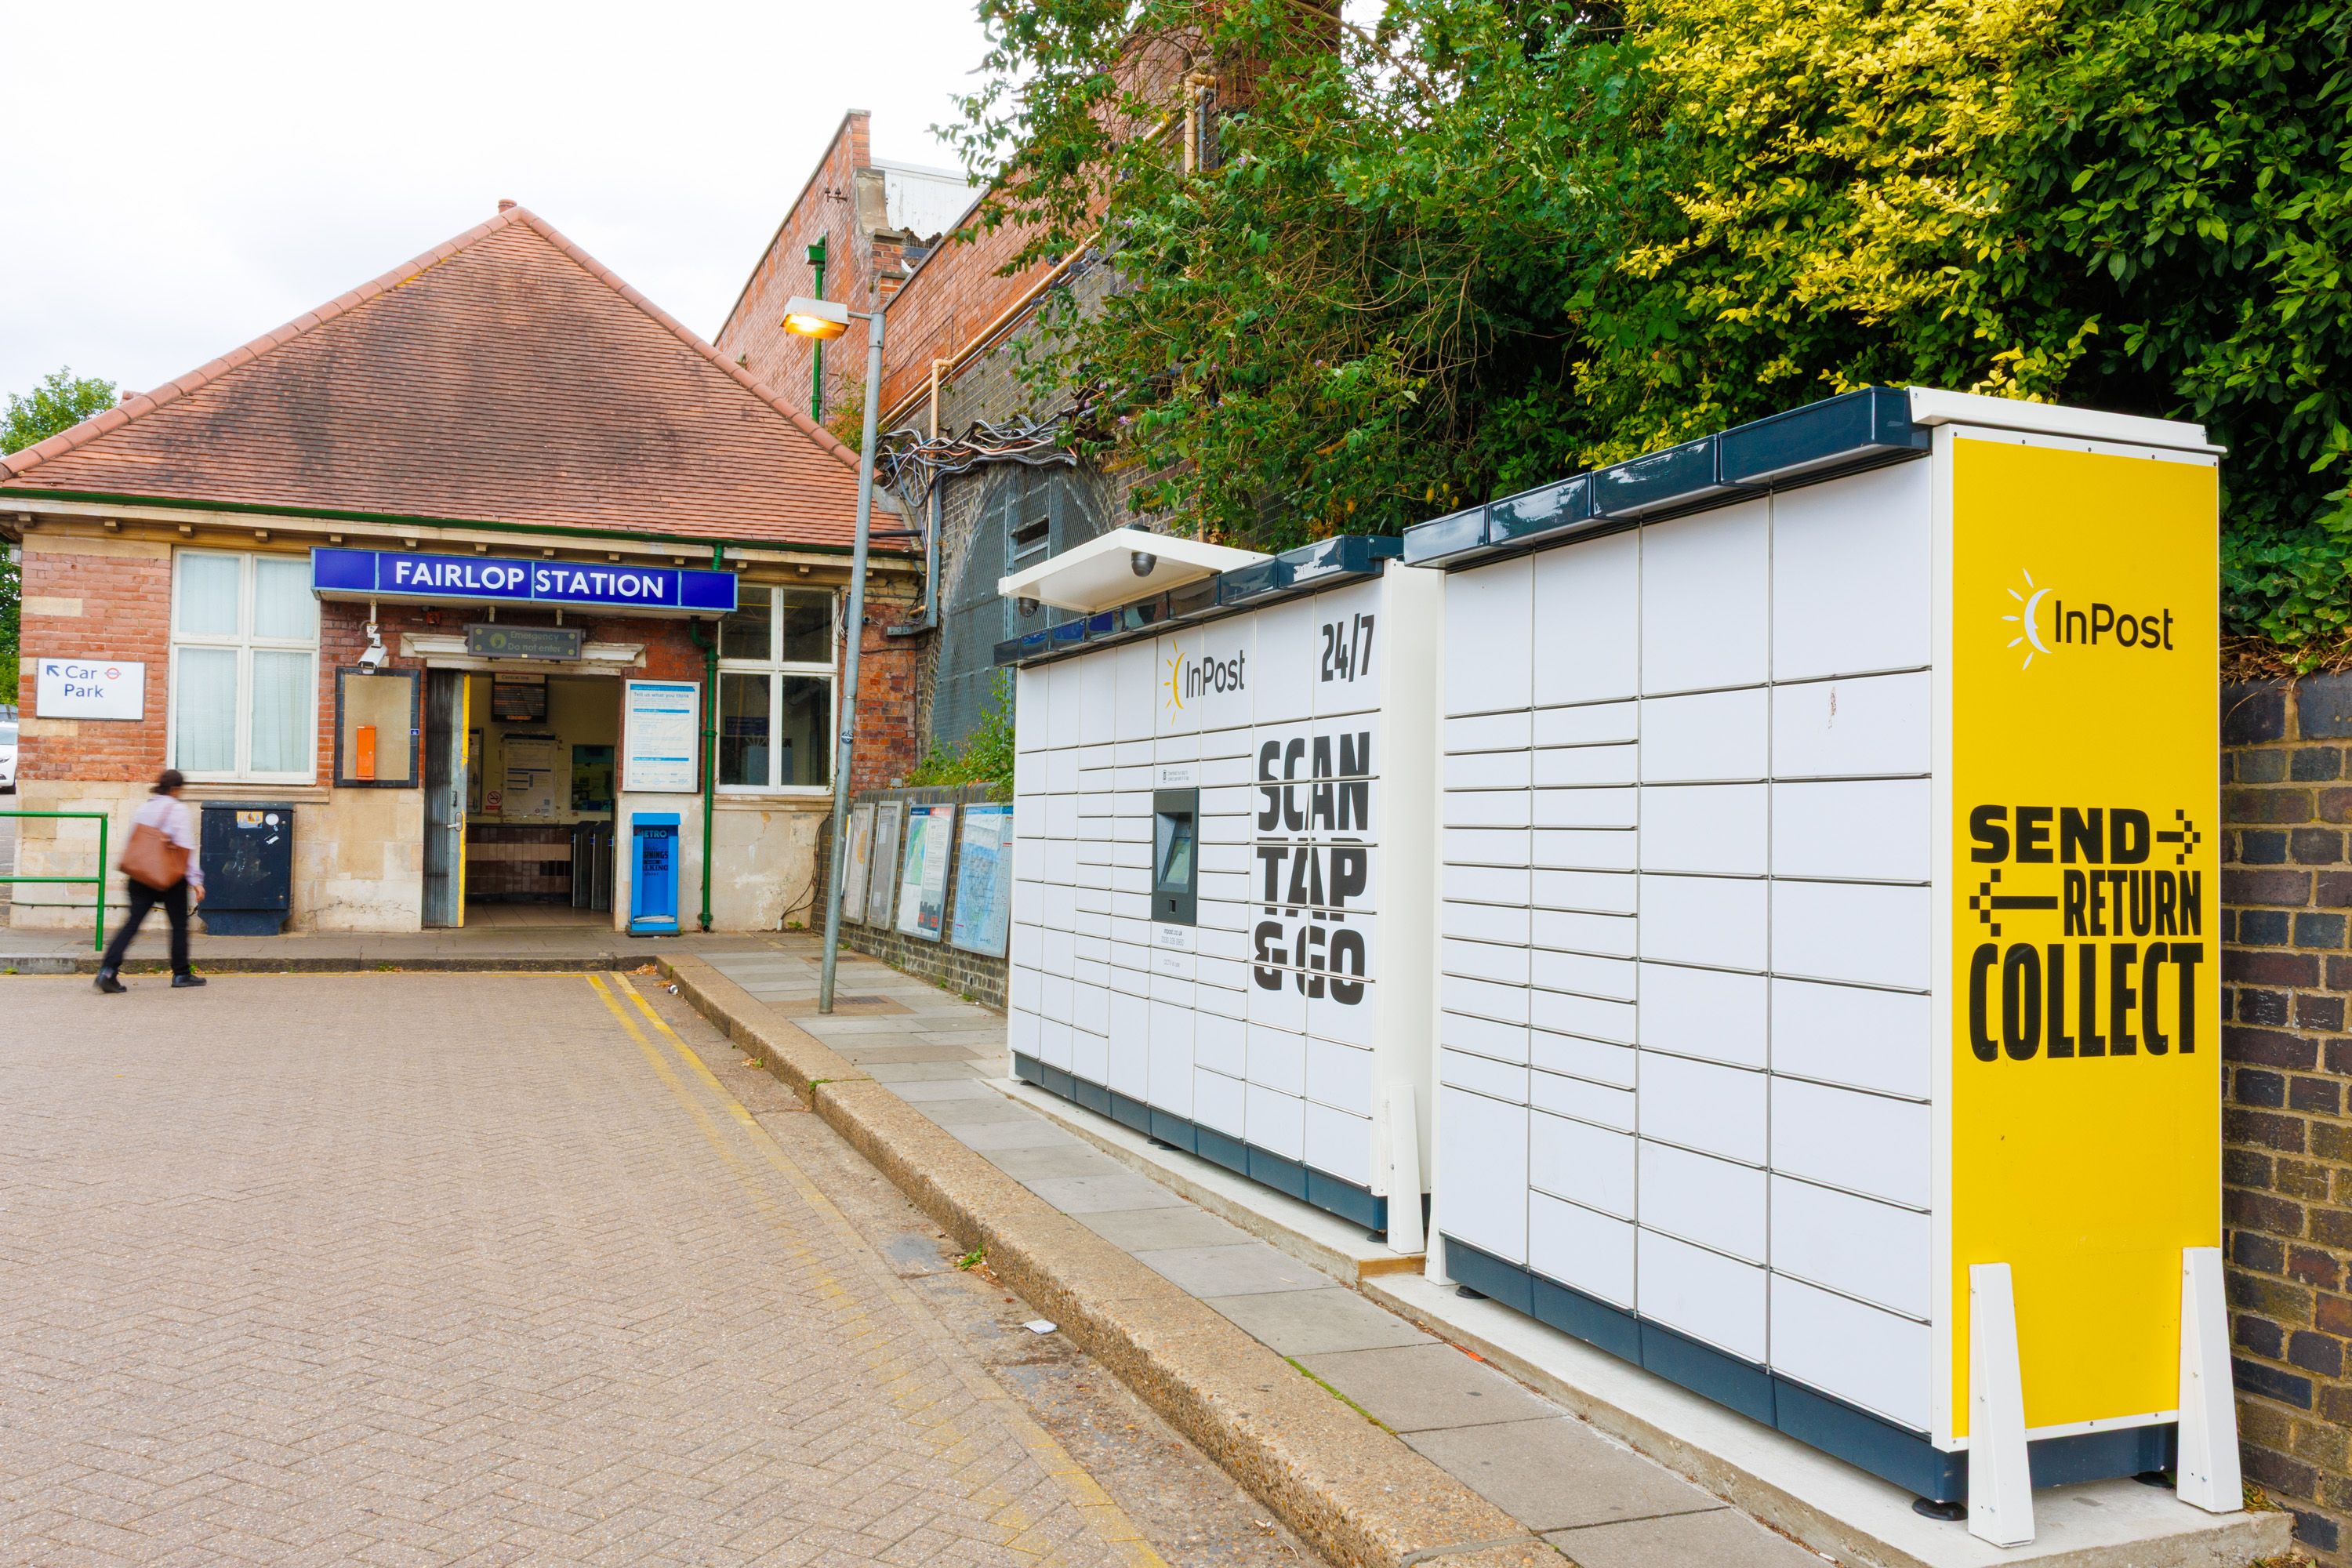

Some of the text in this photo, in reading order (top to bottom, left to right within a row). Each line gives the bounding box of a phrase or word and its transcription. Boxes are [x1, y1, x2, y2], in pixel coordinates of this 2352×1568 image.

[395, 561, 663, 598] FAIRLOP STATION
[510, 631, 560, 641] Emergency
[523, 643, 537, 652] not
[1321, 613, 1375, 683] 24/7
[2055, 600, 2173, 651] InPost
[64, 684, 103, 697] Park
[65, 666, 97, 679] Car
[1185, 649, 1245, 699] InPost
[1258, 731, 1370, 832] SCAN
[1969, 804, 2151, 865] SEND
[1257, 837, 1367, 922] TAP
[2063, 869, 2201, 937] RETURN
[1254, 920, 1366, 1005] & GO
[1969, 942, 2204, 1062] COLLECT
